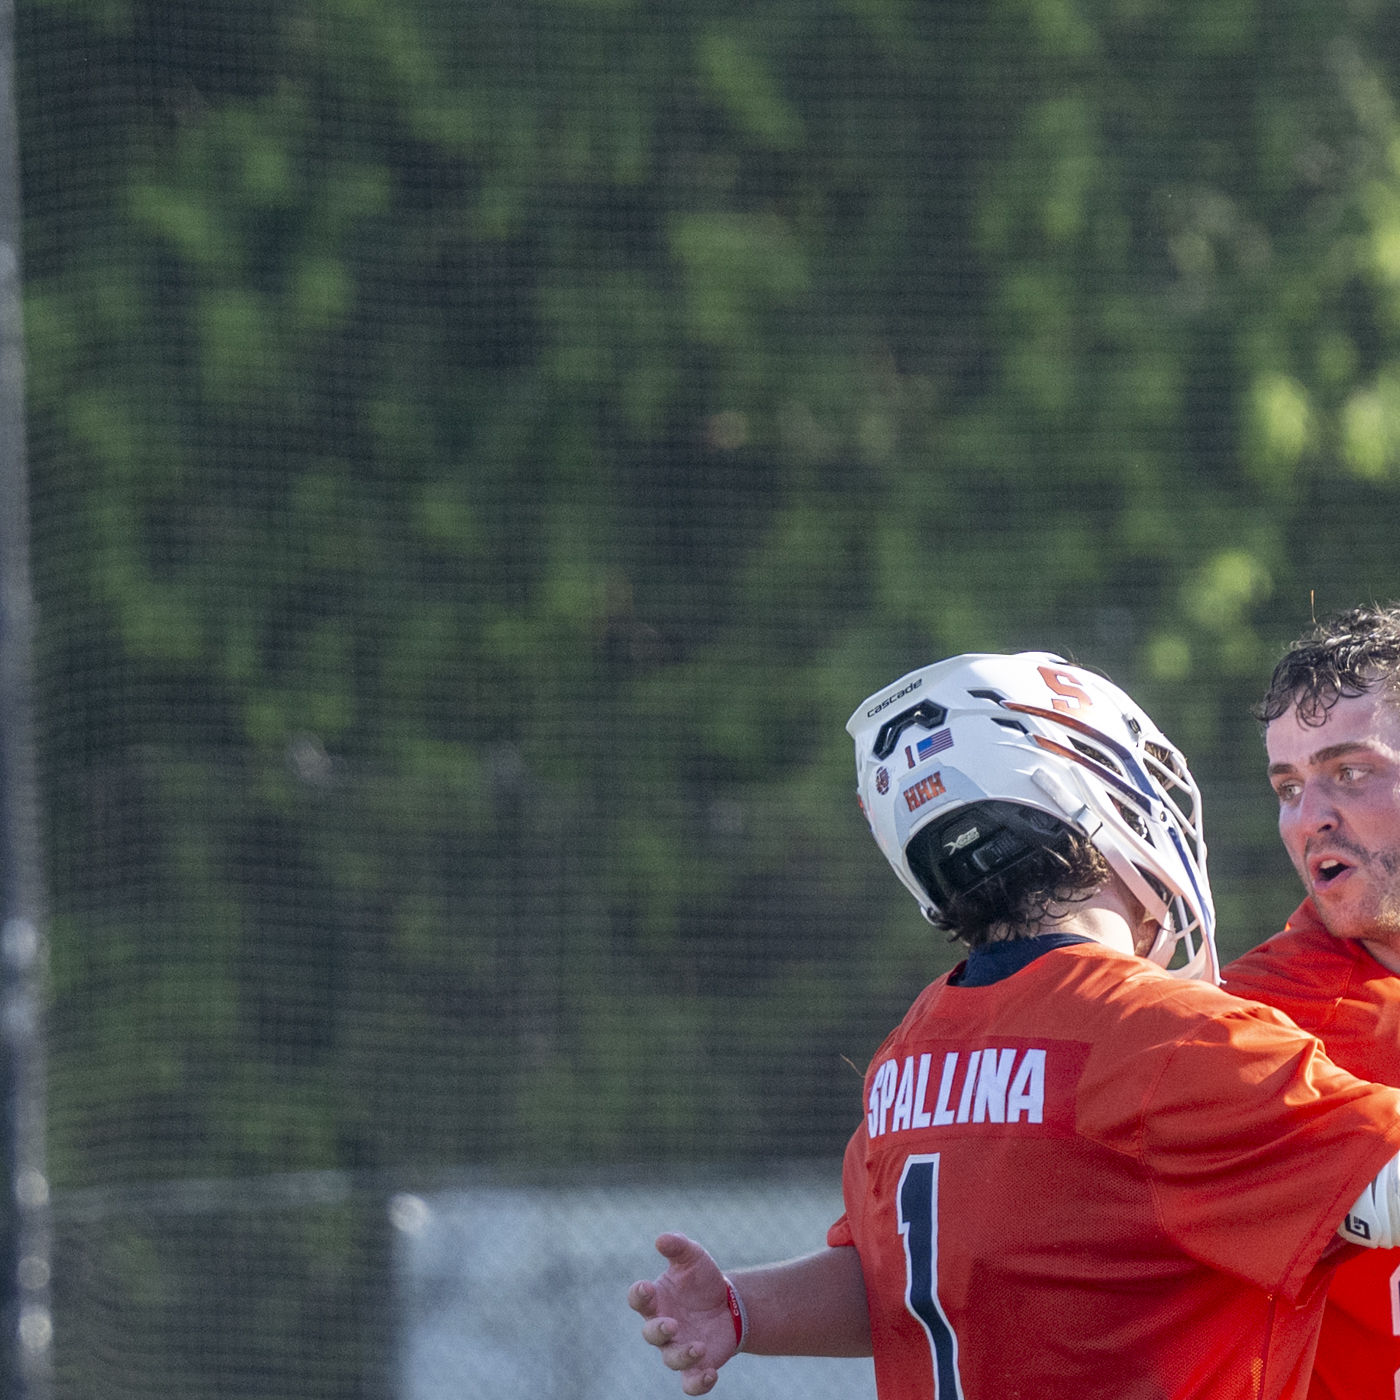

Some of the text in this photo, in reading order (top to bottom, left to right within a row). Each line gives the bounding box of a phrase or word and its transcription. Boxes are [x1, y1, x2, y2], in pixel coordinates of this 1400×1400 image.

[866, 677, 924, 719] cascade
[902, 770, 947, 813] HHH
[866, 1047, 1047, 1140] SPALLINA
